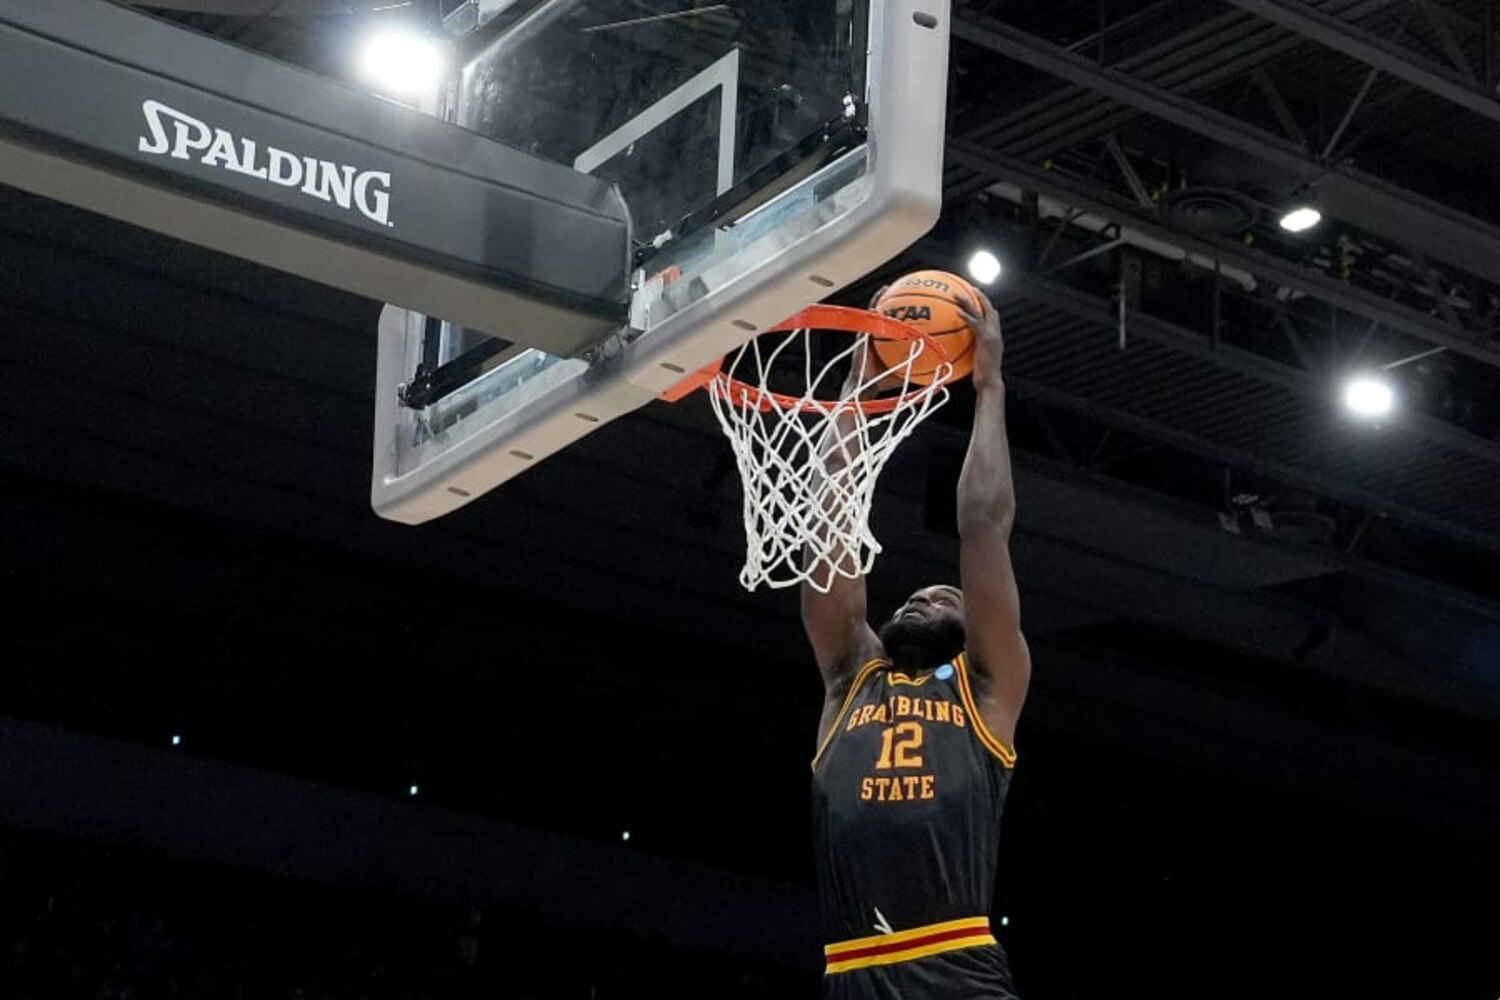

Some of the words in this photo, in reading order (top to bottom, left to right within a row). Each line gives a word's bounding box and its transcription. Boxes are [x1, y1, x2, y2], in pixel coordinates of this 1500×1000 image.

[138, 99, 391, 226] SPALDING
[846, 695, 965, 732] GRABLING
[875, 721, 924, 769] 12
[861, 774, 934, 801] STATE
